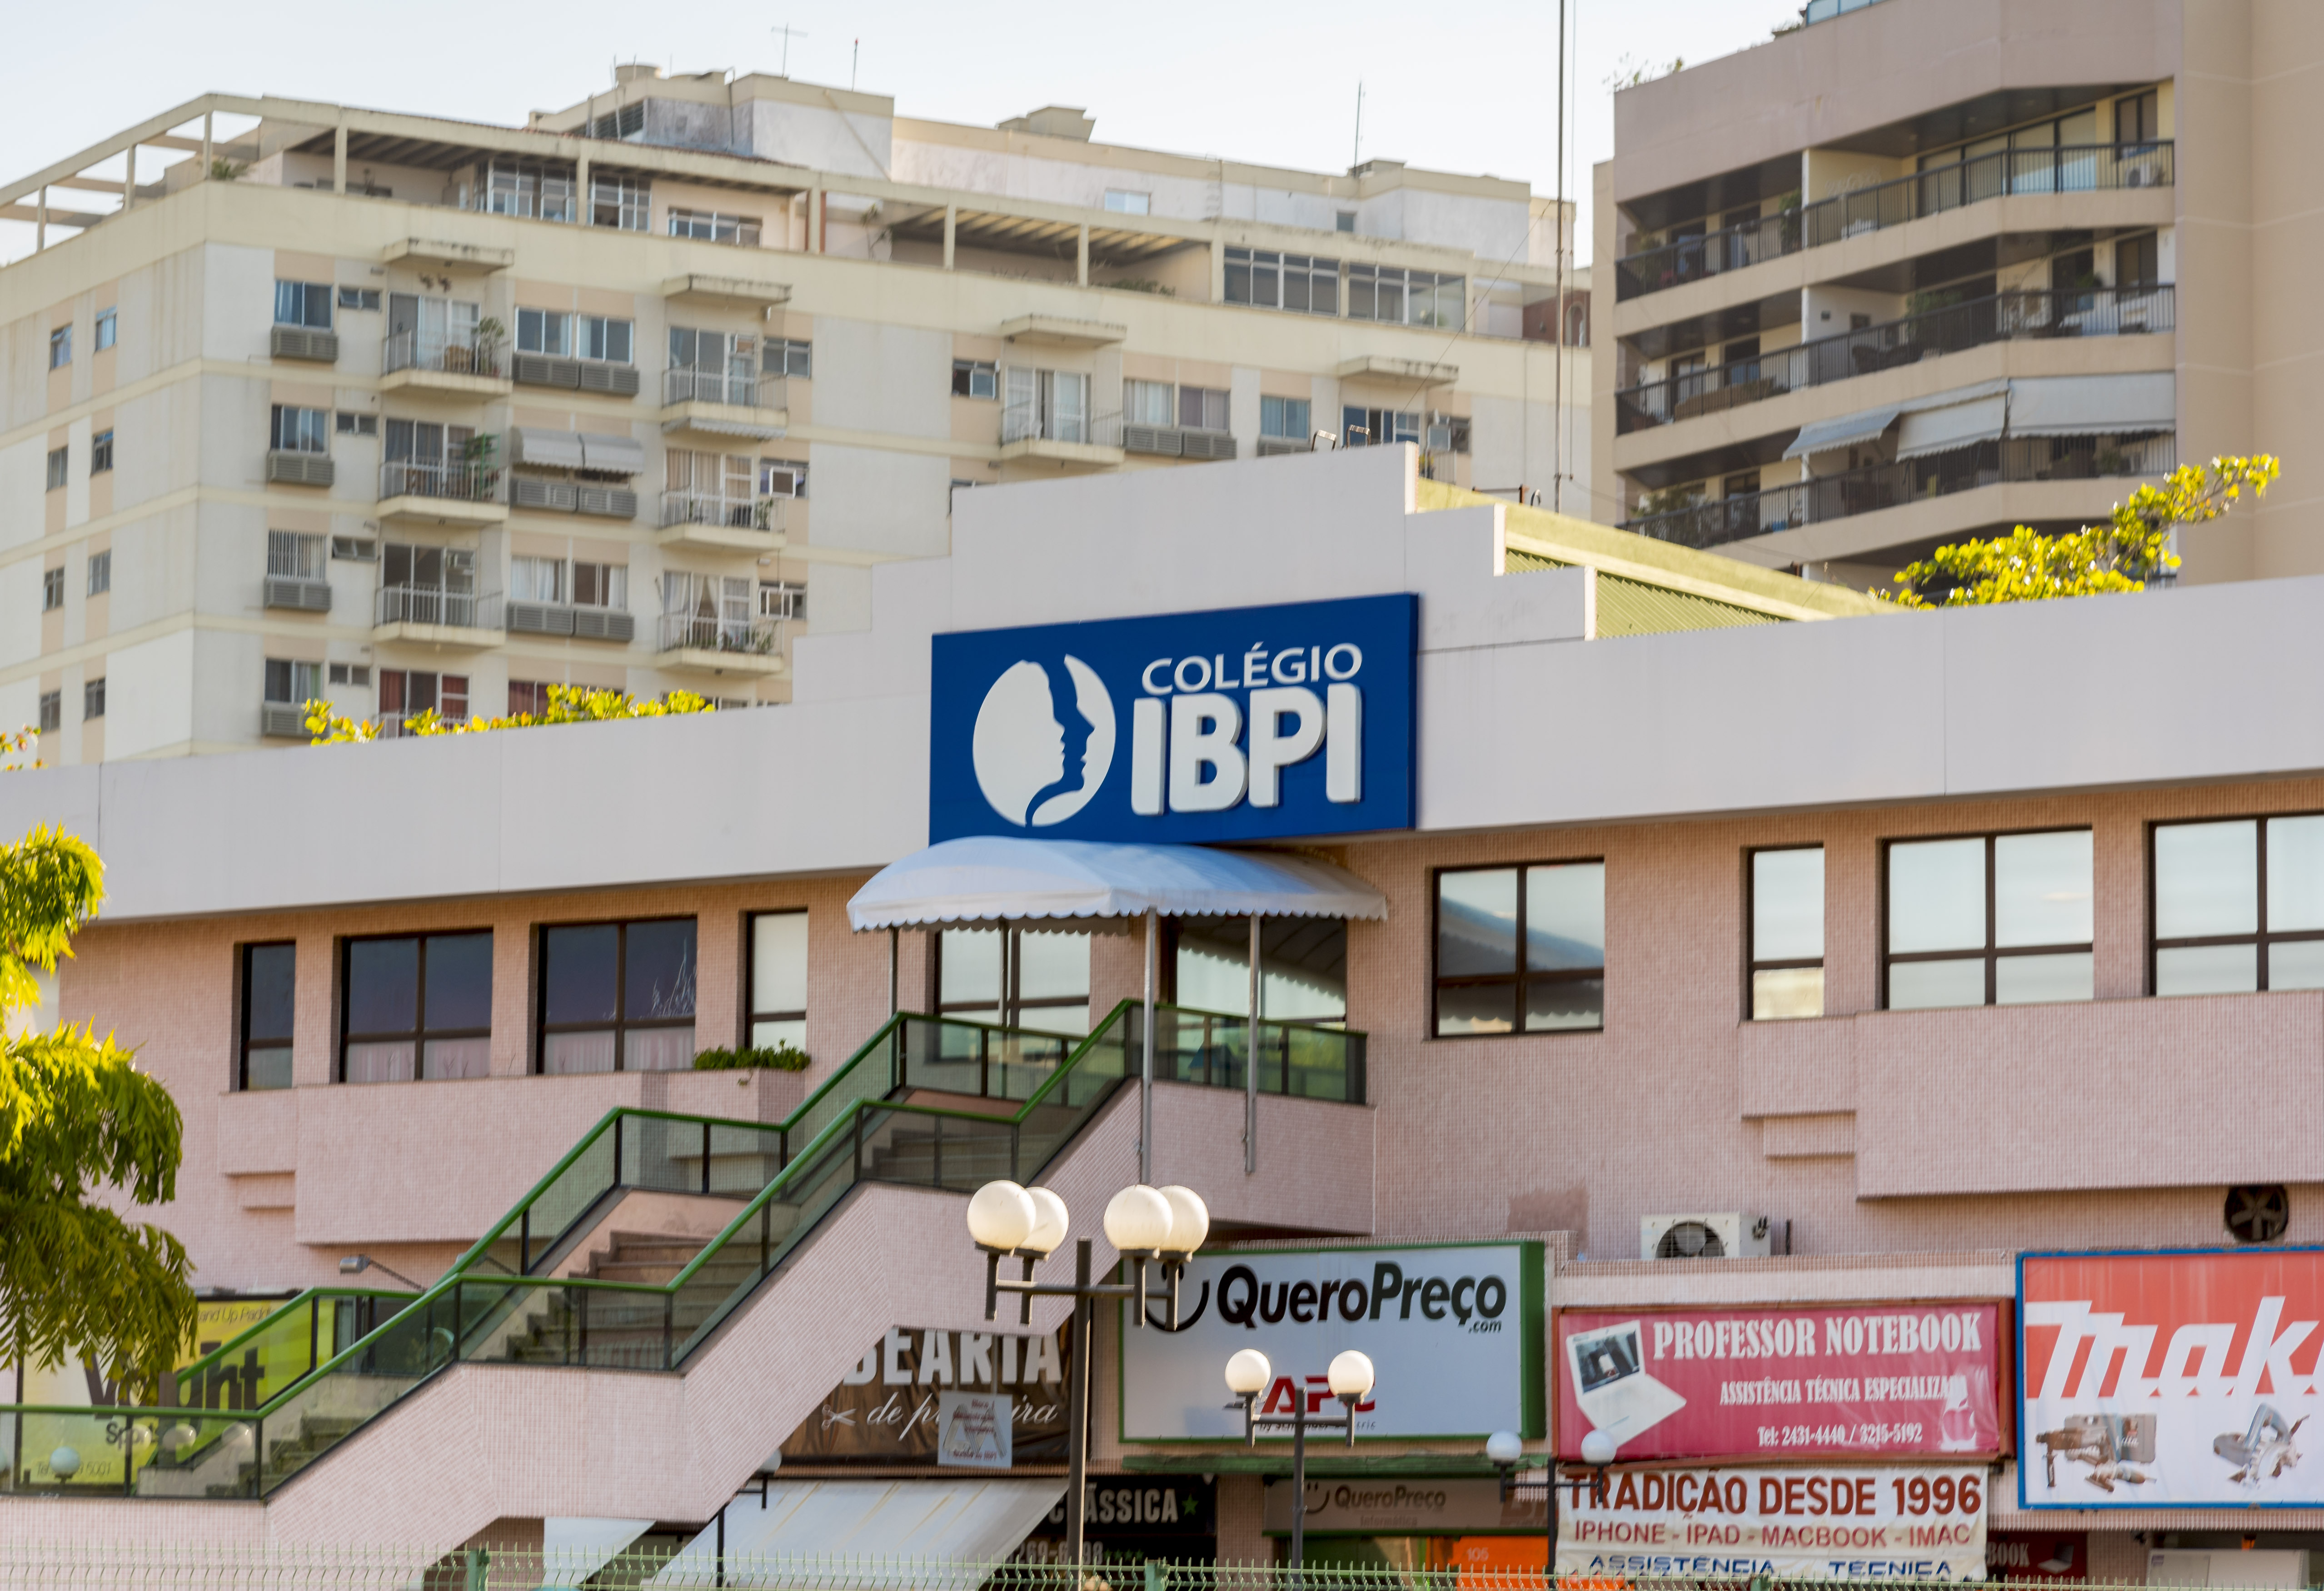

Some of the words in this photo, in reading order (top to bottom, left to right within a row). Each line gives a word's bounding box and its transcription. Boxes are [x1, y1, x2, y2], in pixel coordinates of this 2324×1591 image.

[1142, 641, 1362, 695] COLÉGIO
[1131, 682, 1361, 816] IBPI
[1217, 1261, 1506, 1331] QueroPreço
[222, 1307, 238, 1326] Up
[1468, 1319, 1502, 1334] .com
[1653, 1317, 1815, 1360] PROFESSOR
[1825, 1312, 1982, 1356] NOTEBOOK
[1720, 1376, 1801, 1406] ASSISTÊNCIA
[1805, 1375, 1861, 1403] TÉCNICA
[867, 1391, 903, 1425] de
[1757, 1425, 1779, 1447] Tel:
[1781, 1424, 1846, 1446] 2431-4440
[1860, 1422, 1923, 1444] 3215-5192
[1048, 1482, 1179, 1524] CÁSSICA
[1335, 1484, 1447, 1510] QueroPreço
[1565, 1470, 1748, 1520] TRADIÇÃO
[1759, 1476, 1876, 1516] DESDE
[1891, 1473, 1981, 1516] 1996
[1575, 1520, 1666, 1544] IPHONE
[1686, 1523, 1741, 1545] IPAD
[1762, 1525, 1887, 1546] MACBOOK
[1909, 1523, 1970, 1546] IMAC
[1590, 1555, 1775, 1574] ASSISTÊNCIA
[1828, 1558, 1953, 1576] TÉCNICA
